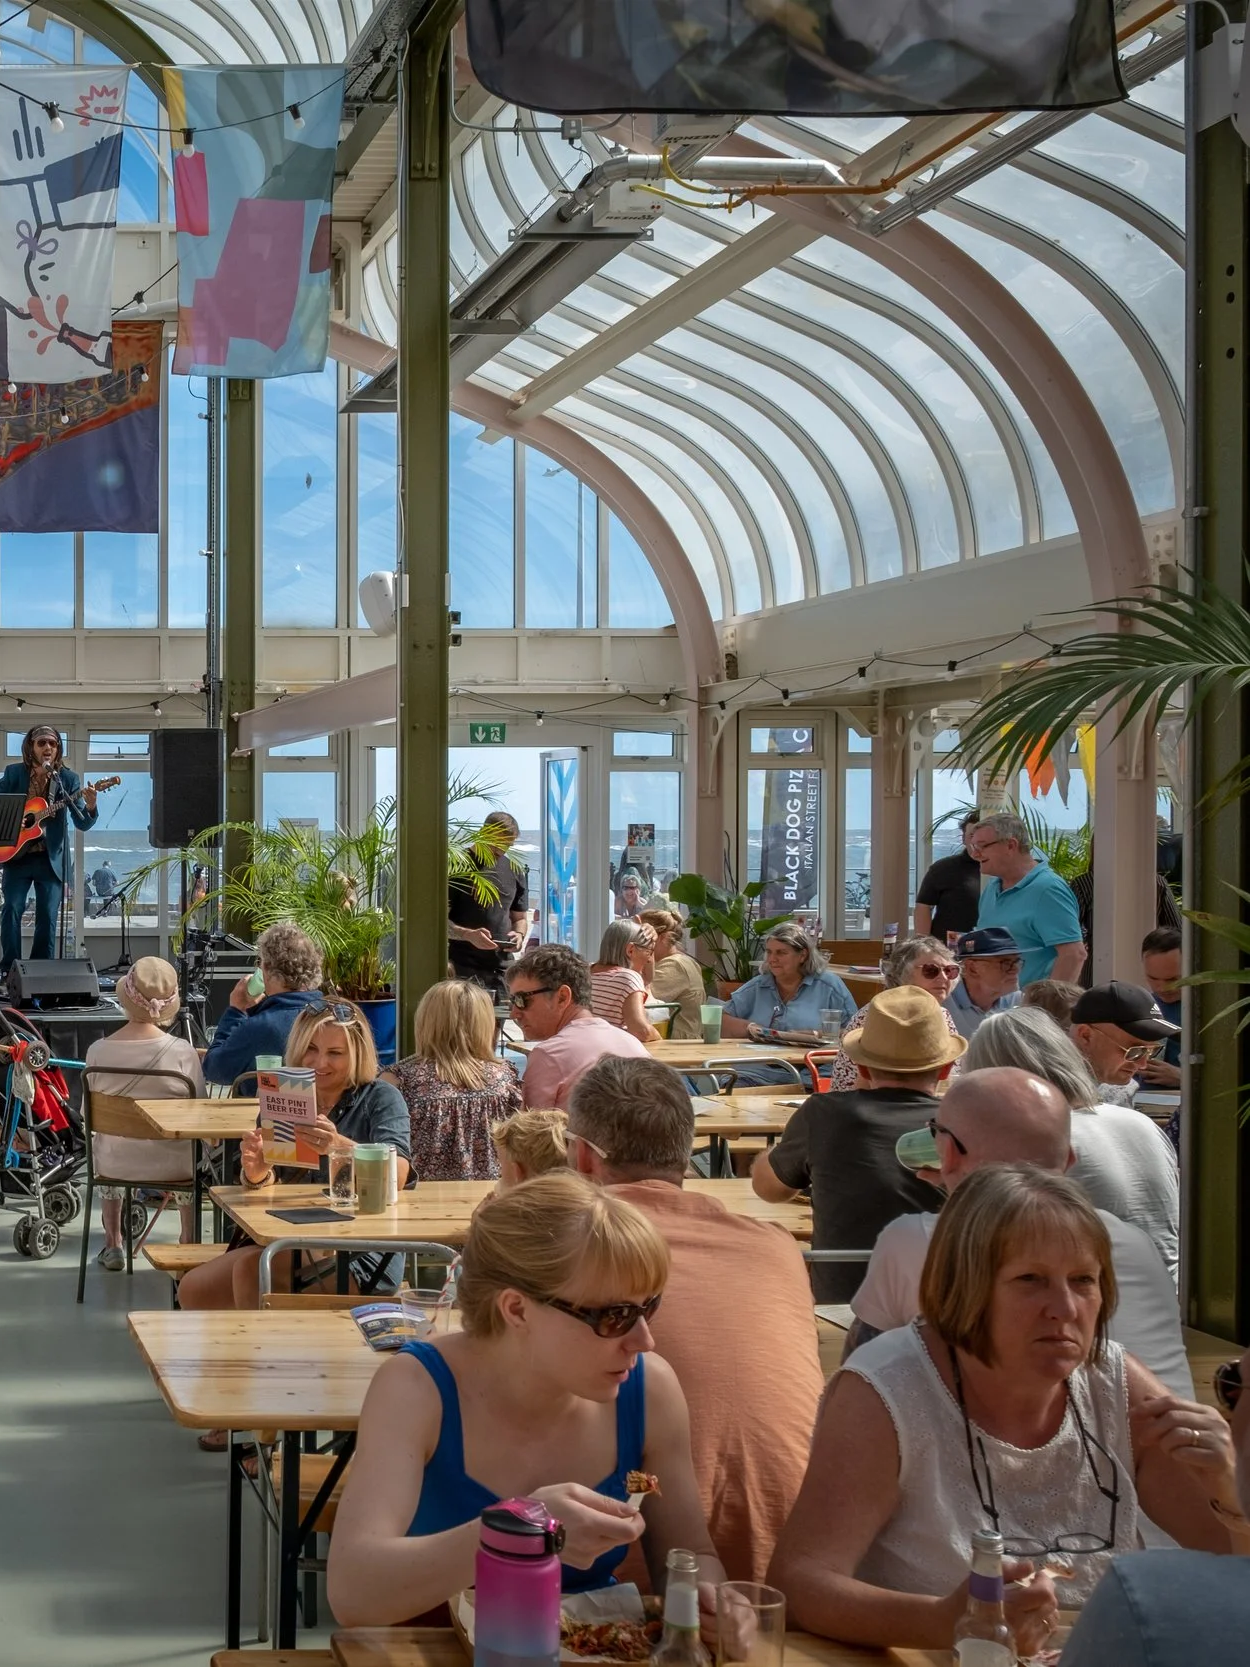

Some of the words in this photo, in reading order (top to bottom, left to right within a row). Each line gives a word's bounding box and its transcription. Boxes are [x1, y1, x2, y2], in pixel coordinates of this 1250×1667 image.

[786, 798, 801, 840] DOG
[805, 783, 817, 822] STREET
[804, 825, 815, 869] ITALIAN
[784, 845, 800, 900] BLACK
[266, 1096, 286, 1105] EAST
[288, 1099, 308, 1108] PINT
[266, 1104, 287, 1112] BEER
[289, 1107, 307, 1115] FEST
